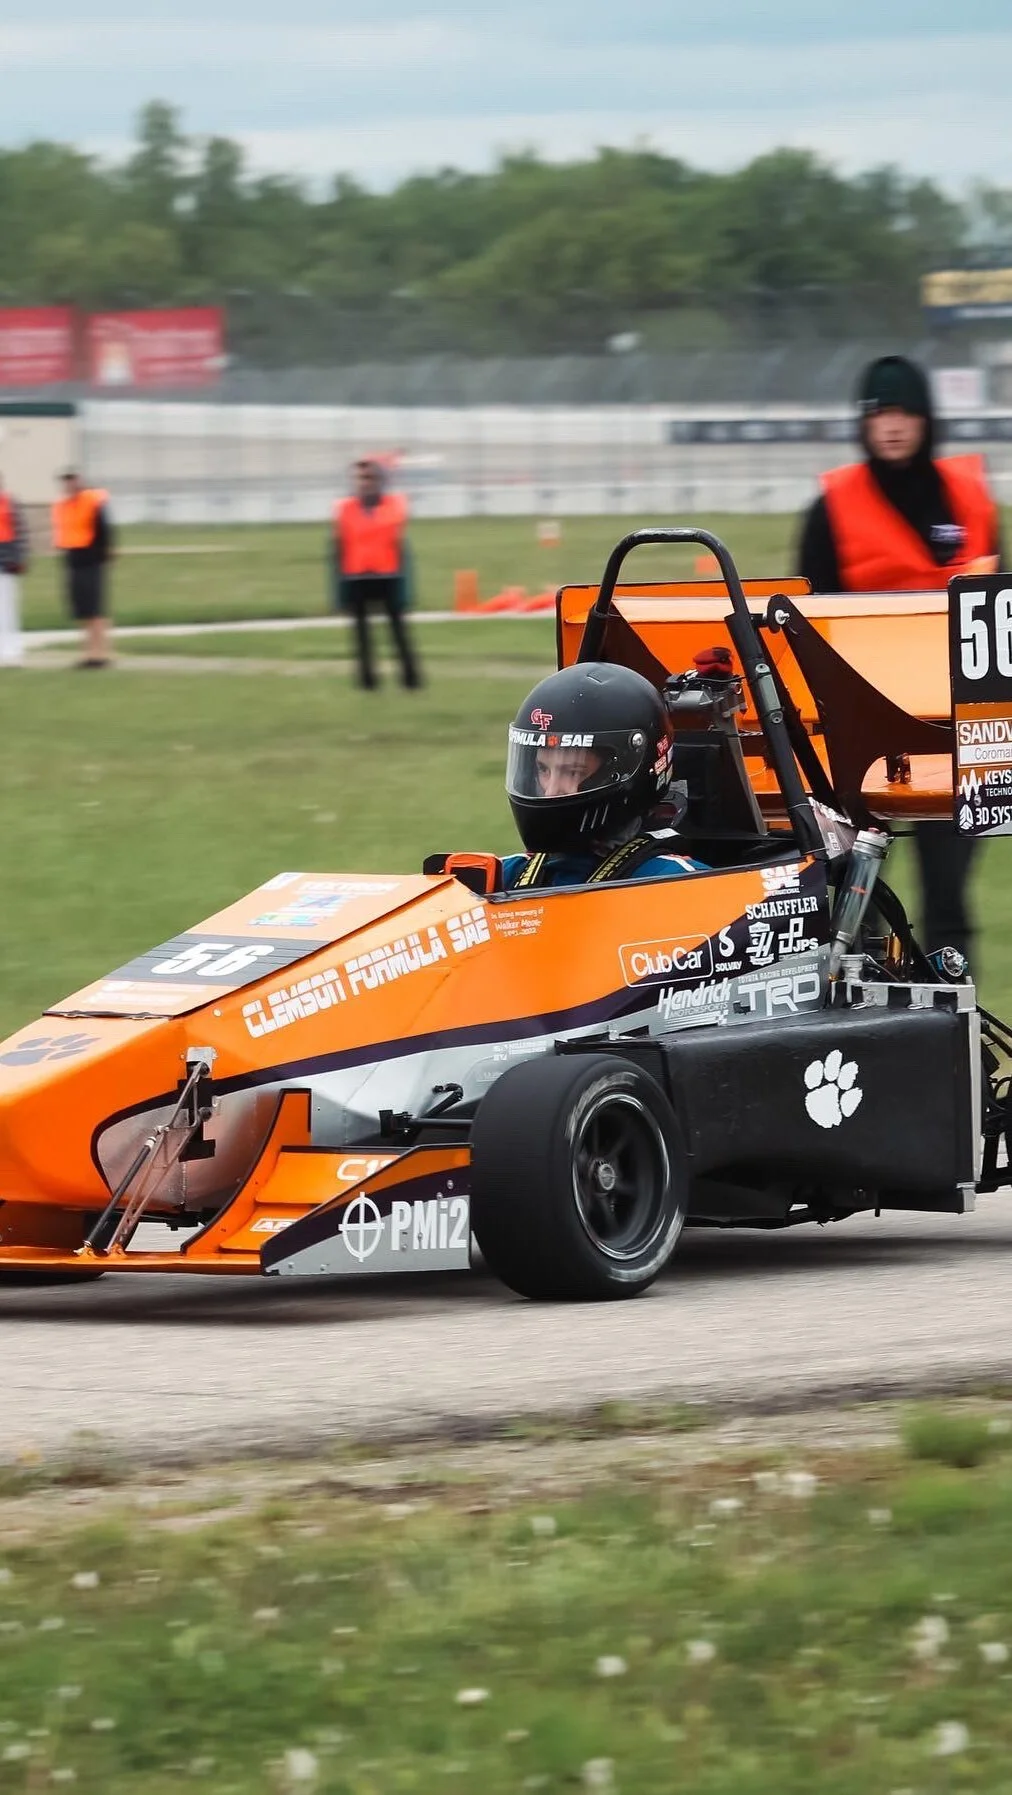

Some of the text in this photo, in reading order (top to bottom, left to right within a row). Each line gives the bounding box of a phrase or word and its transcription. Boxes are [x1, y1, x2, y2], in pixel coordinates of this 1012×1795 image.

[560, 734, 595, 747] SAE
[984, 769, 1012, 786] KEYS
[985, 786, 1012, 797] TECHNO
[975, 805, 1012, 826] 3D SYS
[745, 896, 819, 920] SCHAEFFLER
[792, 937, 819, 953] JPS
[151, 942, 274, 977] 56
[715, 961, 742, 973] SOLVAY
[241, 905, 491, 1038] CLEMSON FORMULA SAE
[657, 977, 732, 1019] Hendrick
[738, 972, 820, 1017] TRD
[391, 1198, 469, 1251] PMi2
